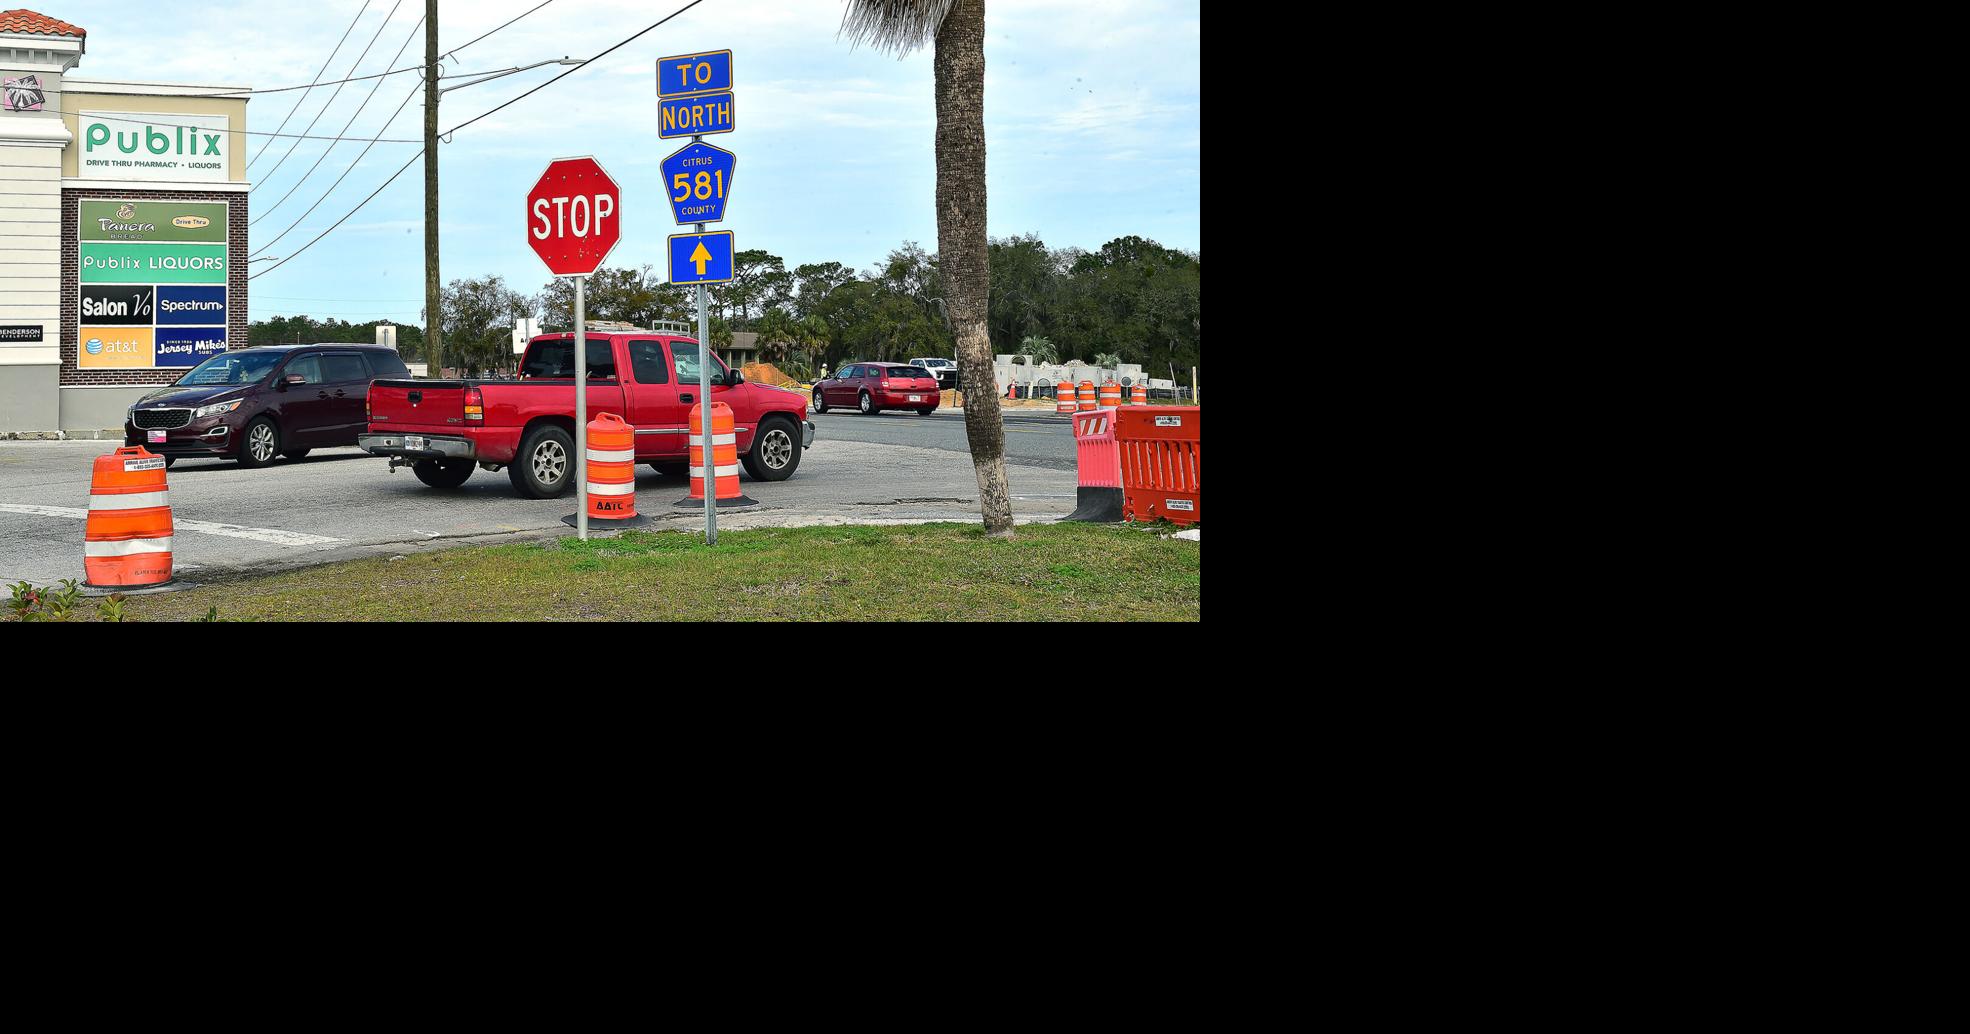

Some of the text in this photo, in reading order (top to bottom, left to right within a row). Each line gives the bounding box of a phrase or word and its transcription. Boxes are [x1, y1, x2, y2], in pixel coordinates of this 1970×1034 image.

[676, 61, 712, 86] TO
[662, 101, 730, 131] NORTH
[86, 123, 221, 156] Publix
[86, 159, 110, 167] DRIVE
[134, 160, 178, 168] PHARMACY
[682, 156, 713, 167] CITRUS
[673, 169, 723, 203] 581
[532, 193, 614, 240] STOP
[681, 204, 716, 215] COUNTY
[98, 218, 156, 232] Panera
[83, 256, 223, 270] Publix LIQUORS
[82, 297, 128, 317] Salon
[161, 299, 220, 313] Spectrum
[105, 339, 138, 353] at&t
[157, 339, 226, 354] Jersey Mike's
